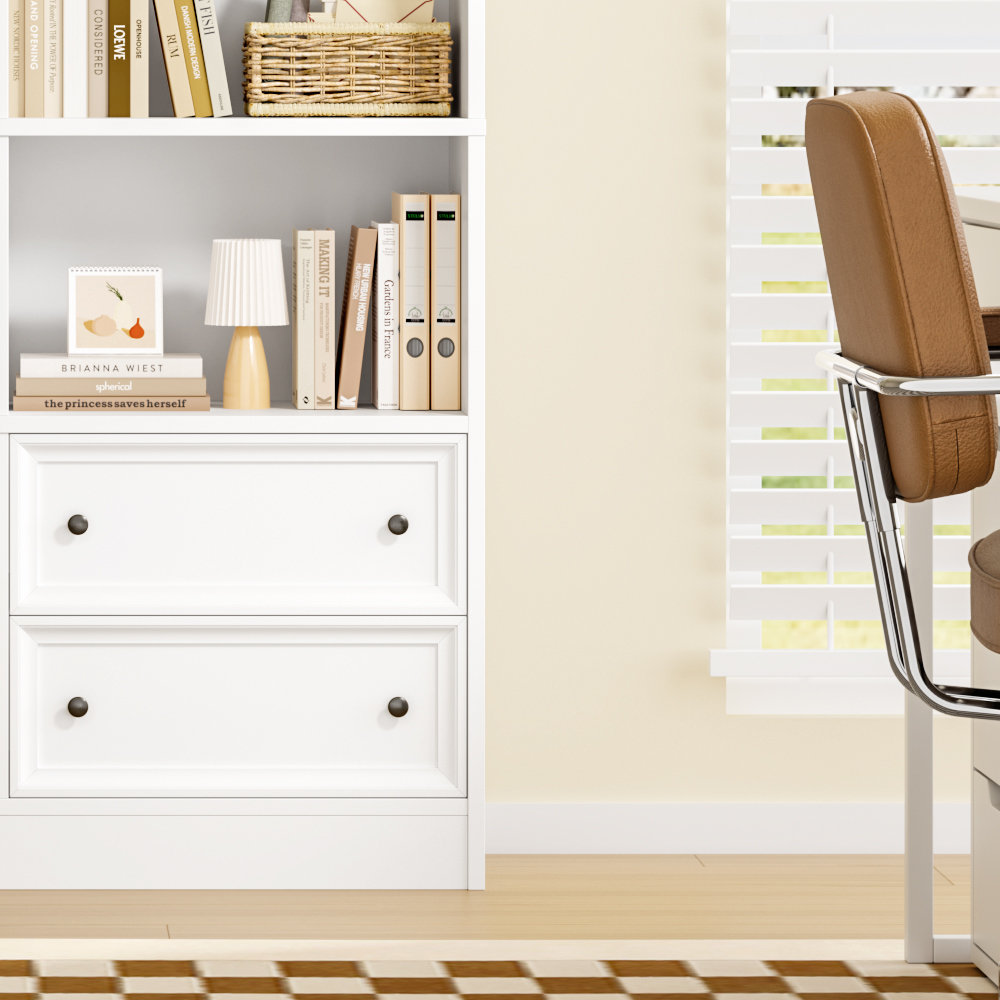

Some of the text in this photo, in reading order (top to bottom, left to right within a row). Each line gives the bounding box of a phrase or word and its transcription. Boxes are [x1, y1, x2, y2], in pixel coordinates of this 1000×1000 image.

[200, 5, 215, 36] FISH
[30, 25, 39, 70] OPENING
[94, 9, 103, 76] CONSIDERED
[113, 24, 125, 60] LOEWE
[166, 34, 180, 58] RUM
[180, 5, 201, 80] DANISH MODERN DESIGN
[319, 239, 330, 284] MAKING
[319, 286, 330, 298] IT
[355, 263, 371, 331] NEW URBAN HOUSING
[384, 280, 394, 359] Gardens in France
[61, 364, 164, 373] BRIANNA WIEST
[44, 399, 63, 408] the
[65, 400, 113, 410] princess
[146, 399, 187, 408] herself
[95, 381, 132, 393] spherical
